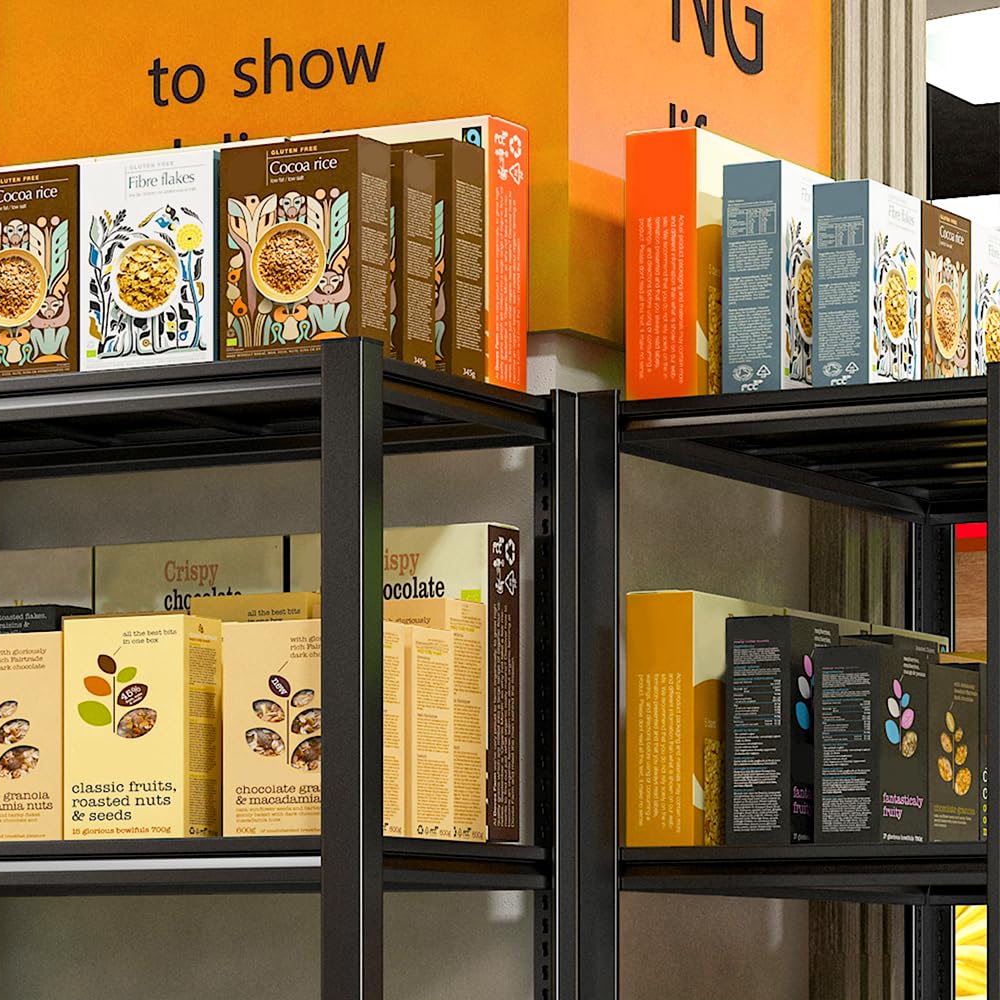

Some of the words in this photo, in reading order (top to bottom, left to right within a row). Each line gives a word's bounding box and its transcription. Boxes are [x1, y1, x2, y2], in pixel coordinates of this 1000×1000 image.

[147, 57, 205, 107] to
[234, 38, 386, 98] show
[270, 147, 298, 156] GLUTEN
[300, 145, 318, 153] FREE
[269, 160, 310, 175] Cocoa
[314, 156, 338, 170] rice
[128, 174, 158, 189] Fibre
[161, 171, 195, 186] flakes
[36, 185, 58, 199] rice
[384, 548, 420, 576] ispy
[164, 560, 218, 586] Crispy
[383, 576, 445, 600] ocolate
[271, 677, 287, 695] new
[72, 782, 124, 793] classic
[129, 780, 176, 792] fruits,
[236, 785, 296, 794] chocolate
[3, 791, 50, 802] granola
[72, 795, 130, 807] roasted
[135, 795, 171, 806] nuts
[236, 796, 247, 805] &
[249, 794, 321, 805] macadamia
[27, 801, 54, 811] nuts
[72, 810, 85, 821] &
[89, 809, 132, 821] seeds
[82, 827, 114, 836] glorious
[116, 826, 149, 834] bowlfuls
